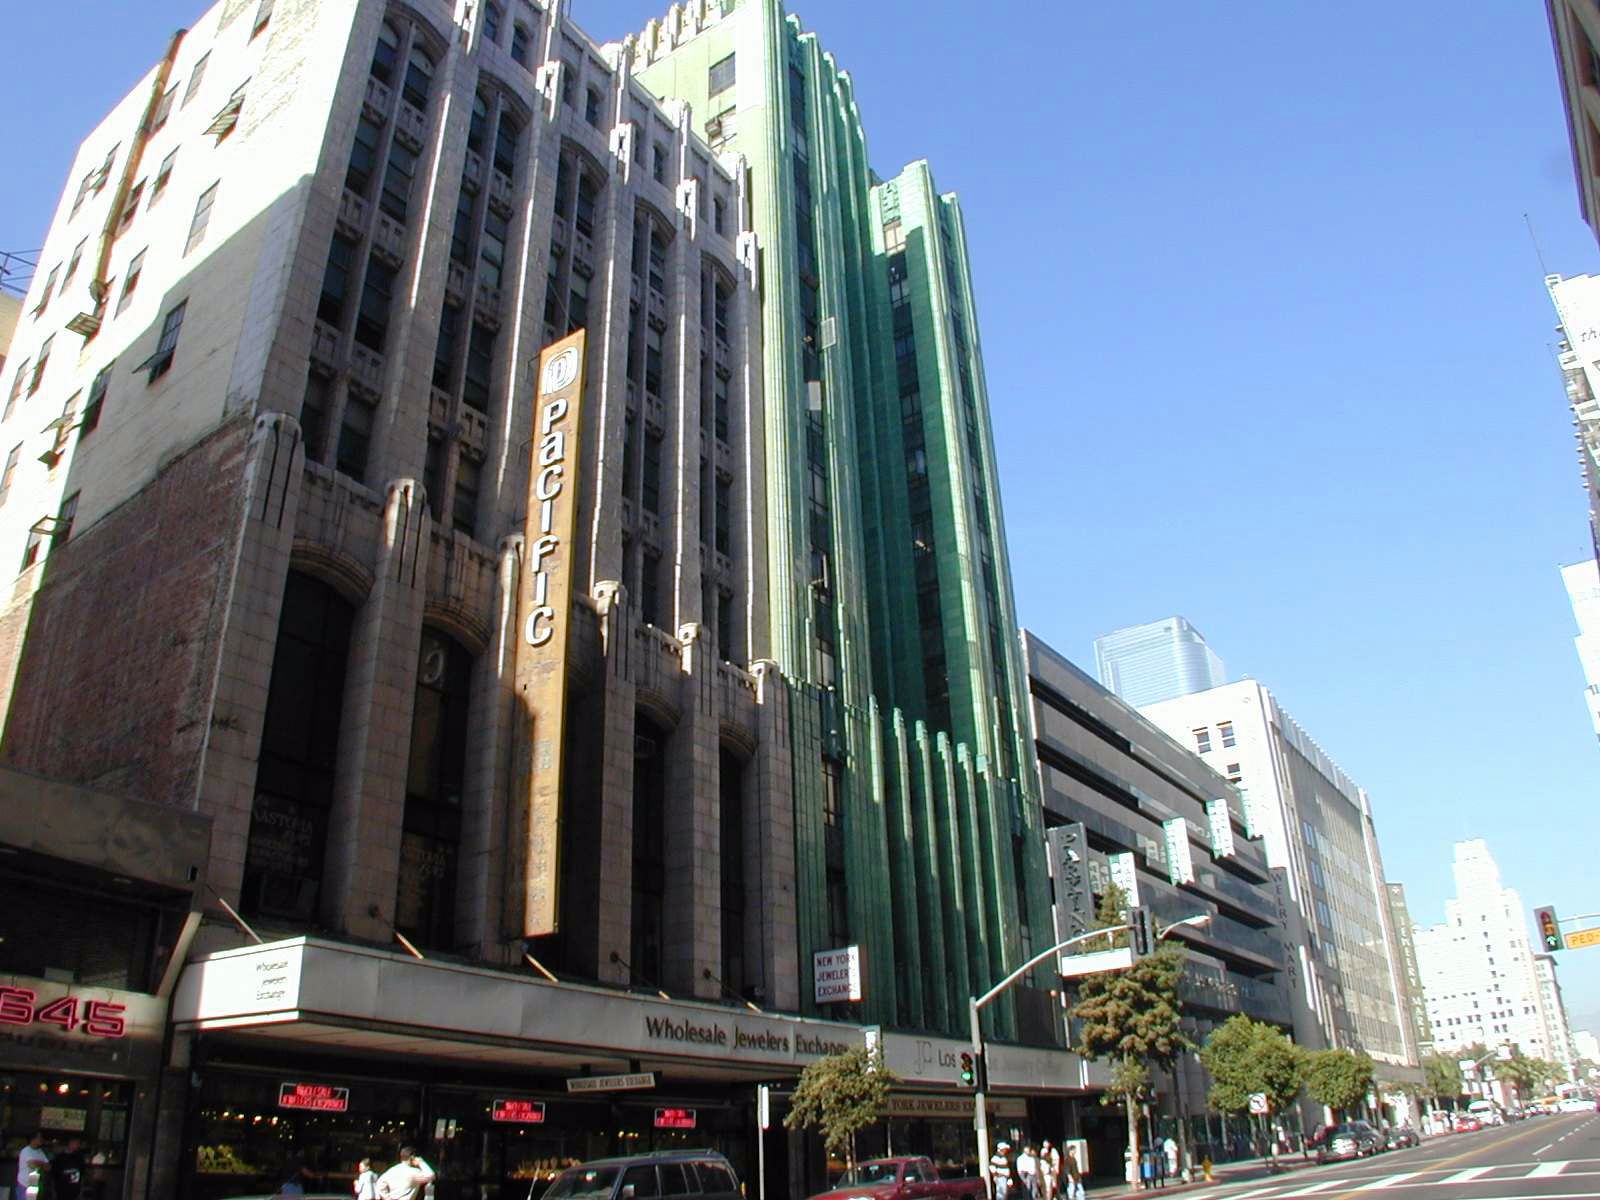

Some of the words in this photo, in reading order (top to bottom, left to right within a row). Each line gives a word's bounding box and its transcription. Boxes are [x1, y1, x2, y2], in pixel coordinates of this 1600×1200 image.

[817, 956, 833, 968] NEW
[836, 952, 856, 966] YORK
[1283, 942, 1297, 989] MART
[1400, 915, 1417, 987] JEWELRY
[1411, 996, 1425, 1037] MART
[646, 1016, 726, 1046] Wholesale
[734, 1026, 789, 1053] Jewelers
[938, 1048, 957, 1068] Los
